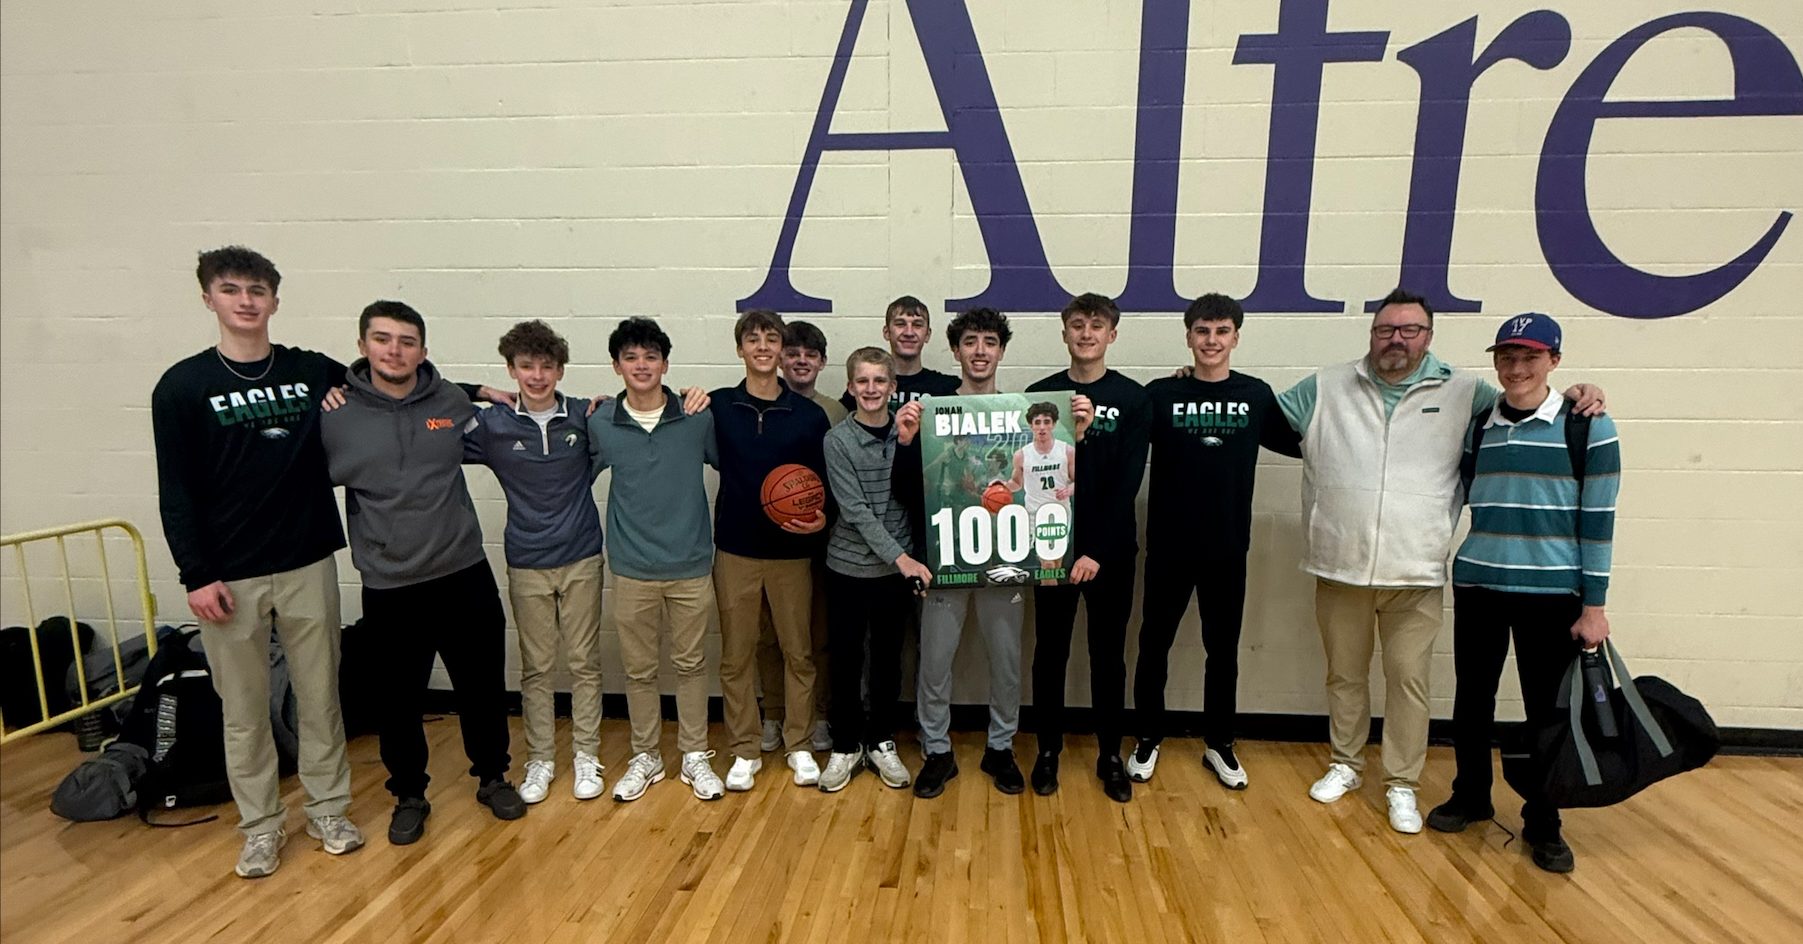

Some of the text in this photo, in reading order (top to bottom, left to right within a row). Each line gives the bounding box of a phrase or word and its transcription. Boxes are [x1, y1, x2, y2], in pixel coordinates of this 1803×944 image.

[209, 382, 311, 426] EAGLES
[935, 406, 962, 415] JONAH
[1172, 401, 1250, 428] EAGLES
[935, 411, 1022, 436] BIALEK
[931, 503, 1068, 565] 1000
[1036, 526, 1066, 537] POINTS
[937, 568, 1066, 584] FILLMORE EAGLES
